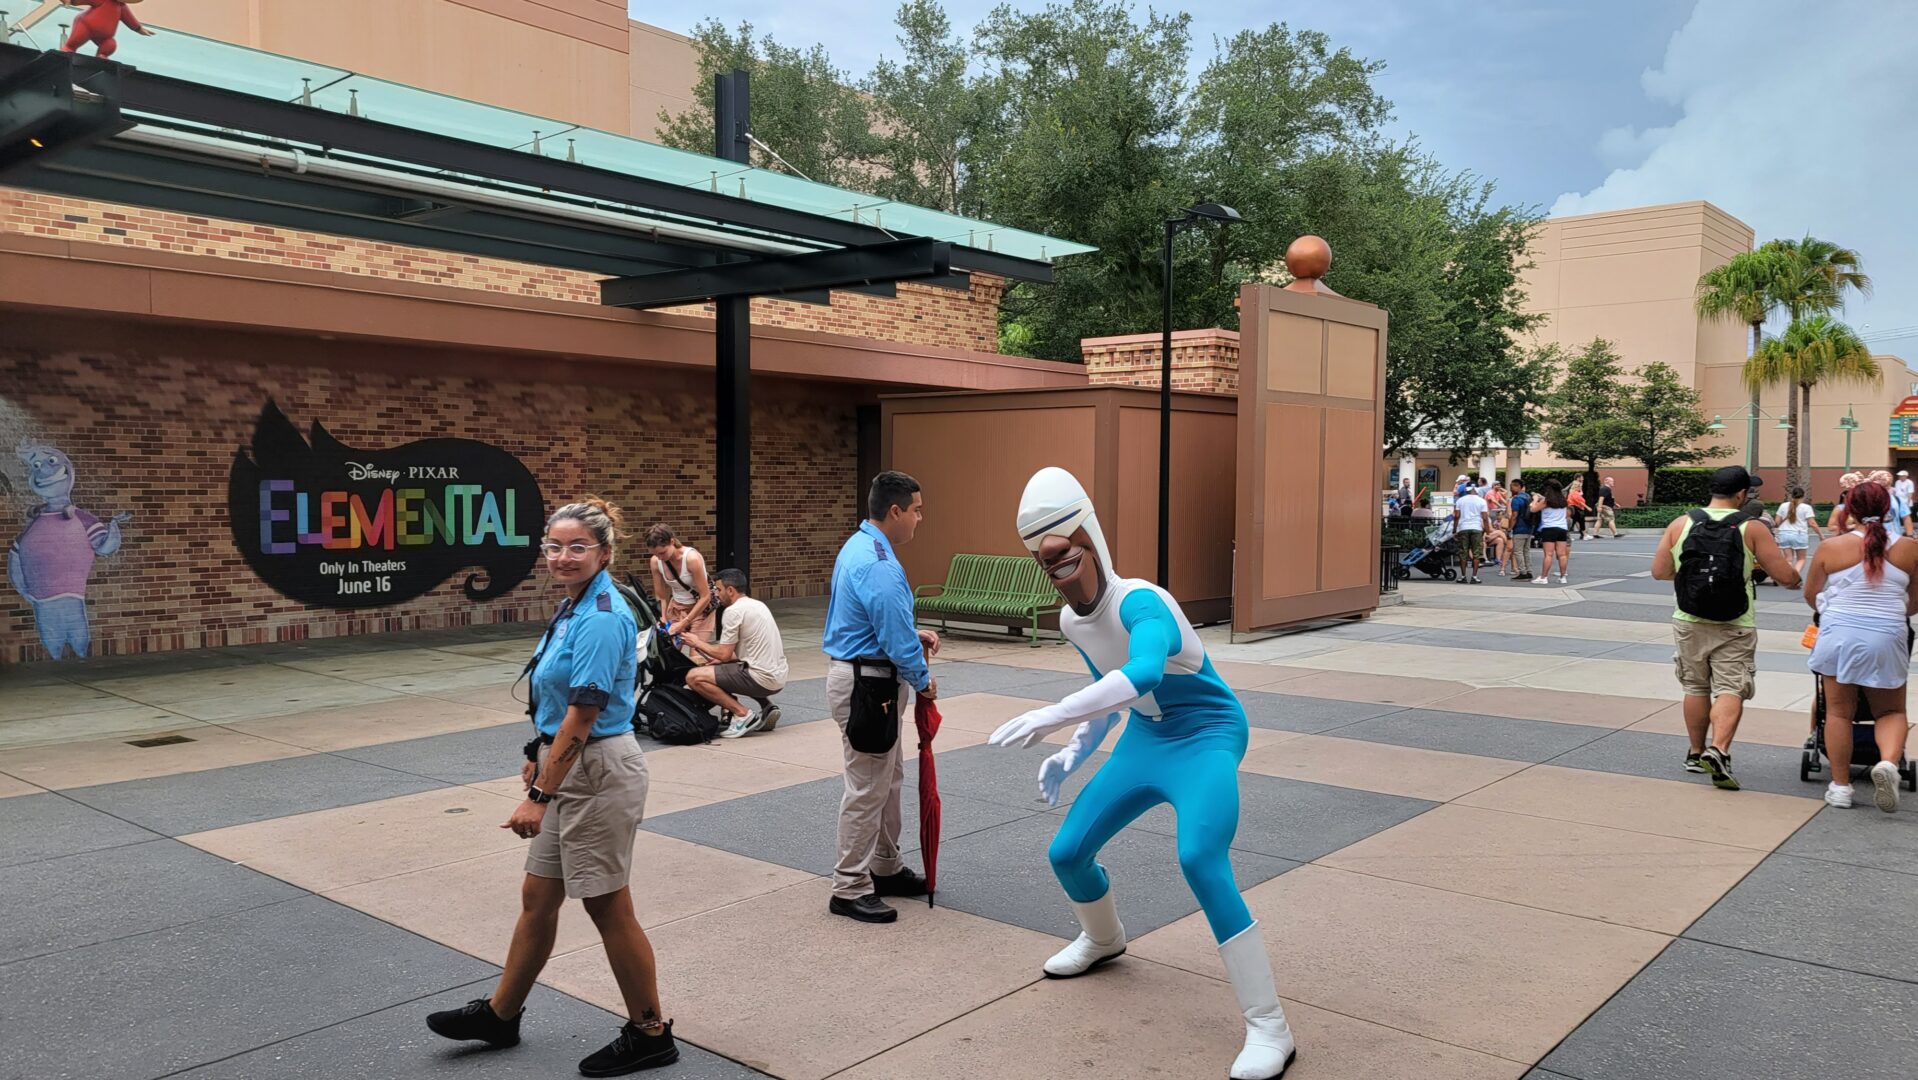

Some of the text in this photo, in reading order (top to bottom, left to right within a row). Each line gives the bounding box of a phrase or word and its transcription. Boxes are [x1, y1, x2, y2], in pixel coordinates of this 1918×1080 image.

[344, 461, 460, 485] Disney PIXAR
[259, 479, 530, 554] ELEMENTAL
[319, 559, 406, 576] Only In Theaters
[337, 575, 391, 595] June 16
